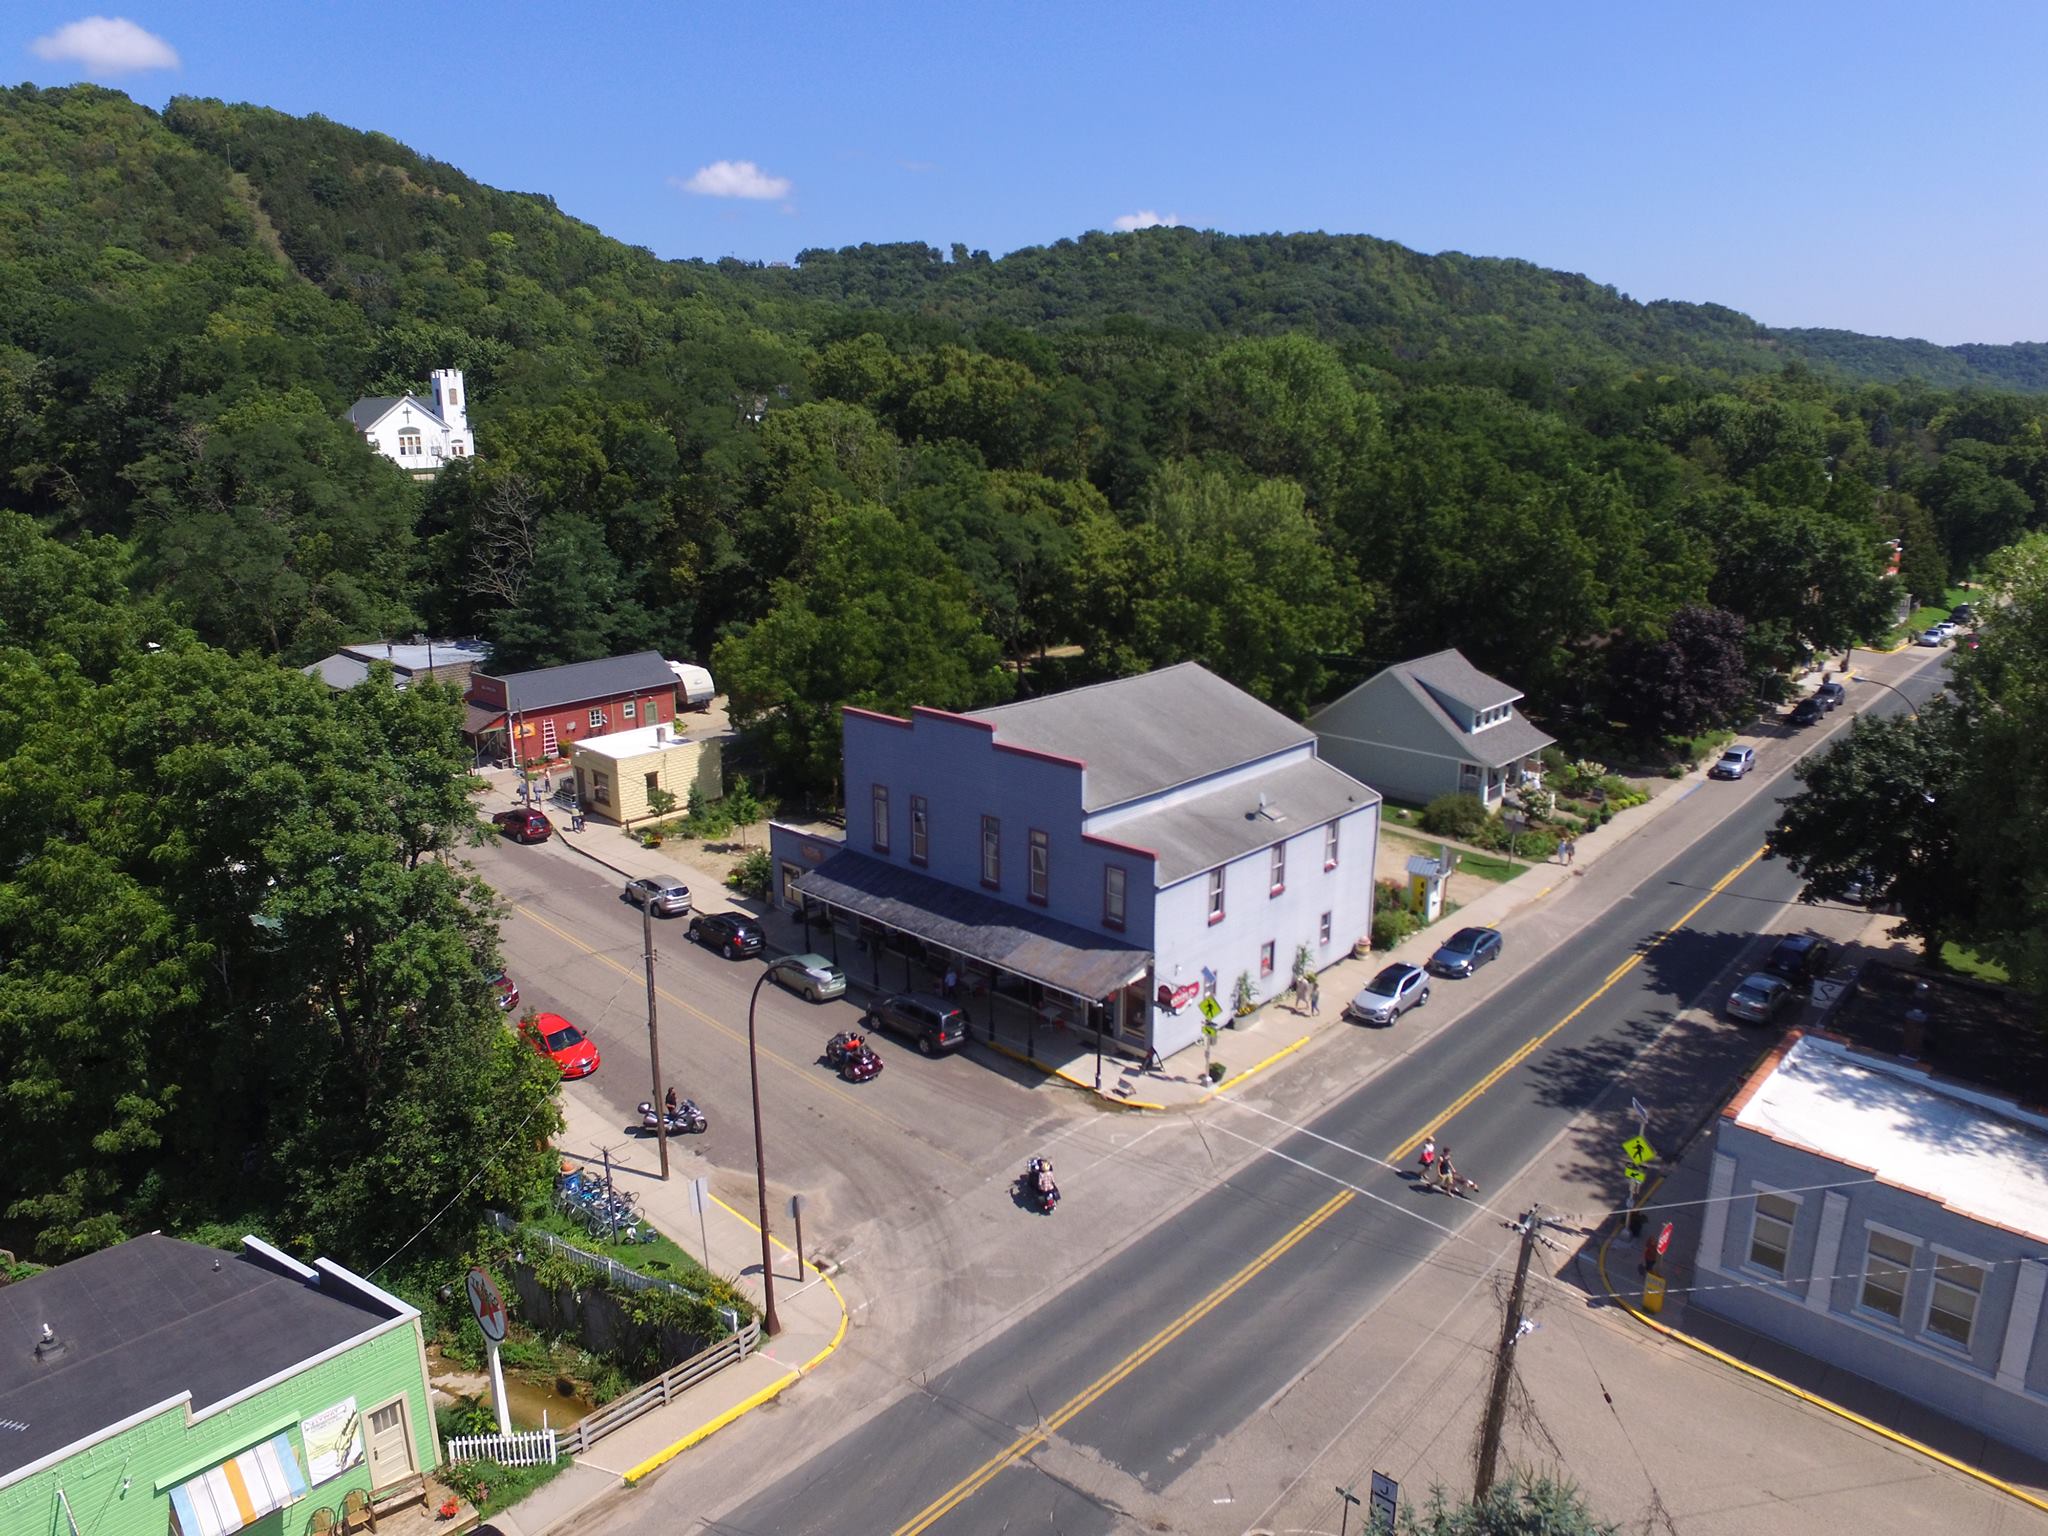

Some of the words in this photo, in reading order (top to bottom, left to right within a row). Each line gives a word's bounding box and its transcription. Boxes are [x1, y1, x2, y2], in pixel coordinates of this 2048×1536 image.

[1657, 1231, 1670, 1250] STOP
[469, 1275, 500, 1308] TEXACO
[1380, 1486, 1389, 1495] J
